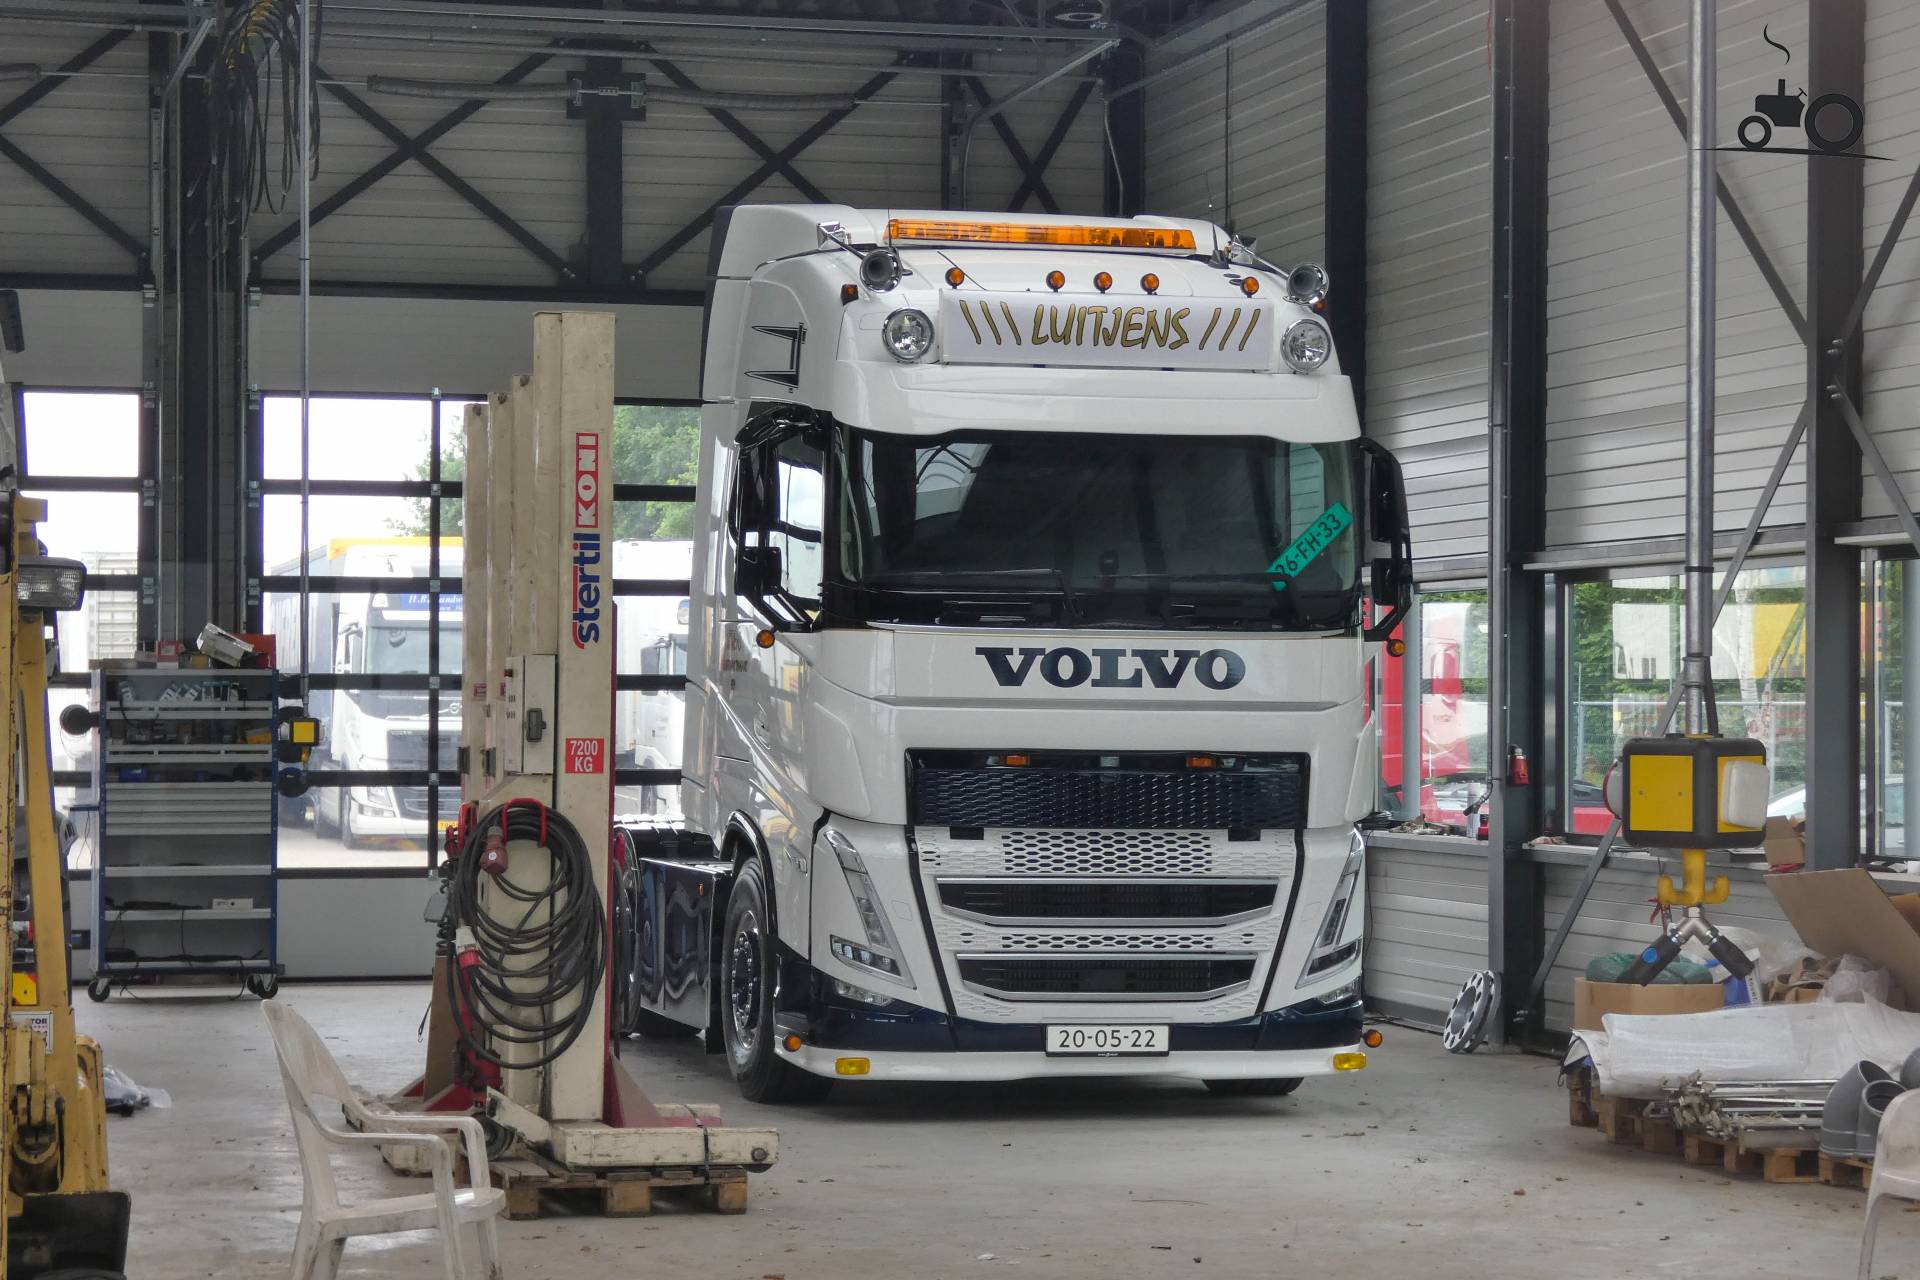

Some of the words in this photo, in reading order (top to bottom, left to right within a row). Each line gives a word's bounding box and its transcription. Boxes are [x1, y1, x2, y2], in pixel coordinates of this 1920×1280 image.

[1031, 303, 1190, 350] LUITJENS
[576, 432, 599, 528] KONI
[572, 532, 601, 650] stertil
[975, 646, 1247, 690] VOLVO
[569, 739, 599, 756] 7200
[574, 756, 594, 773] KG
[1058, 1029, 1156, 1048] 20-05-22
